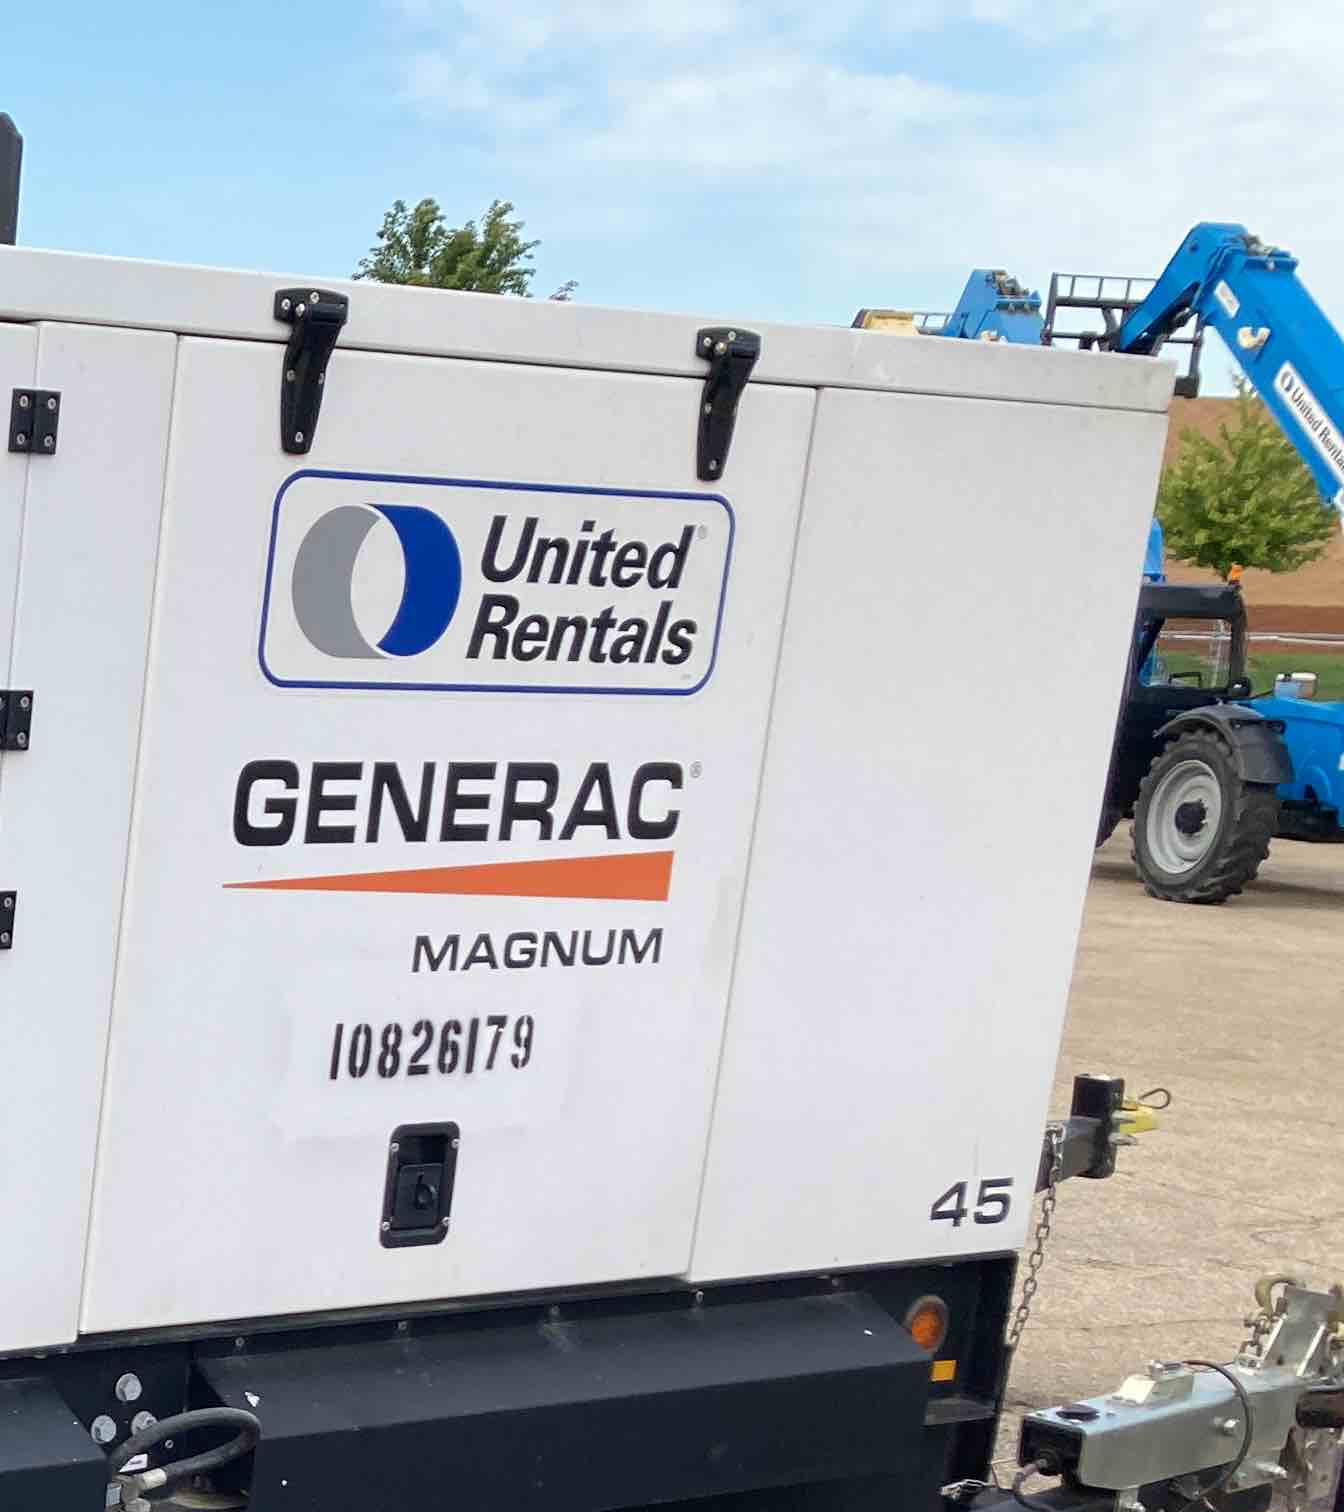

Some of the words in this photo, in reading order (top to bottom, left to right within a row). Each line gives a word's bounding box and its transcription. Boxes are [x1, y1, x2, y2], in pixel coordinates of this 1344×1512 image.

[1292, 386, 1322, 432] United
[1318, 424, 1344, 471] Renta
[480, 515, 695, 590] United
[464, 593, 698, 665] Rentals
[232, 760, 683, 847] GENERAC
[412, 928, 664, 973] MAGNUM
[330, 1015, 535, 1080] 10826179
[929, 1177, 1014, 1228] 45
